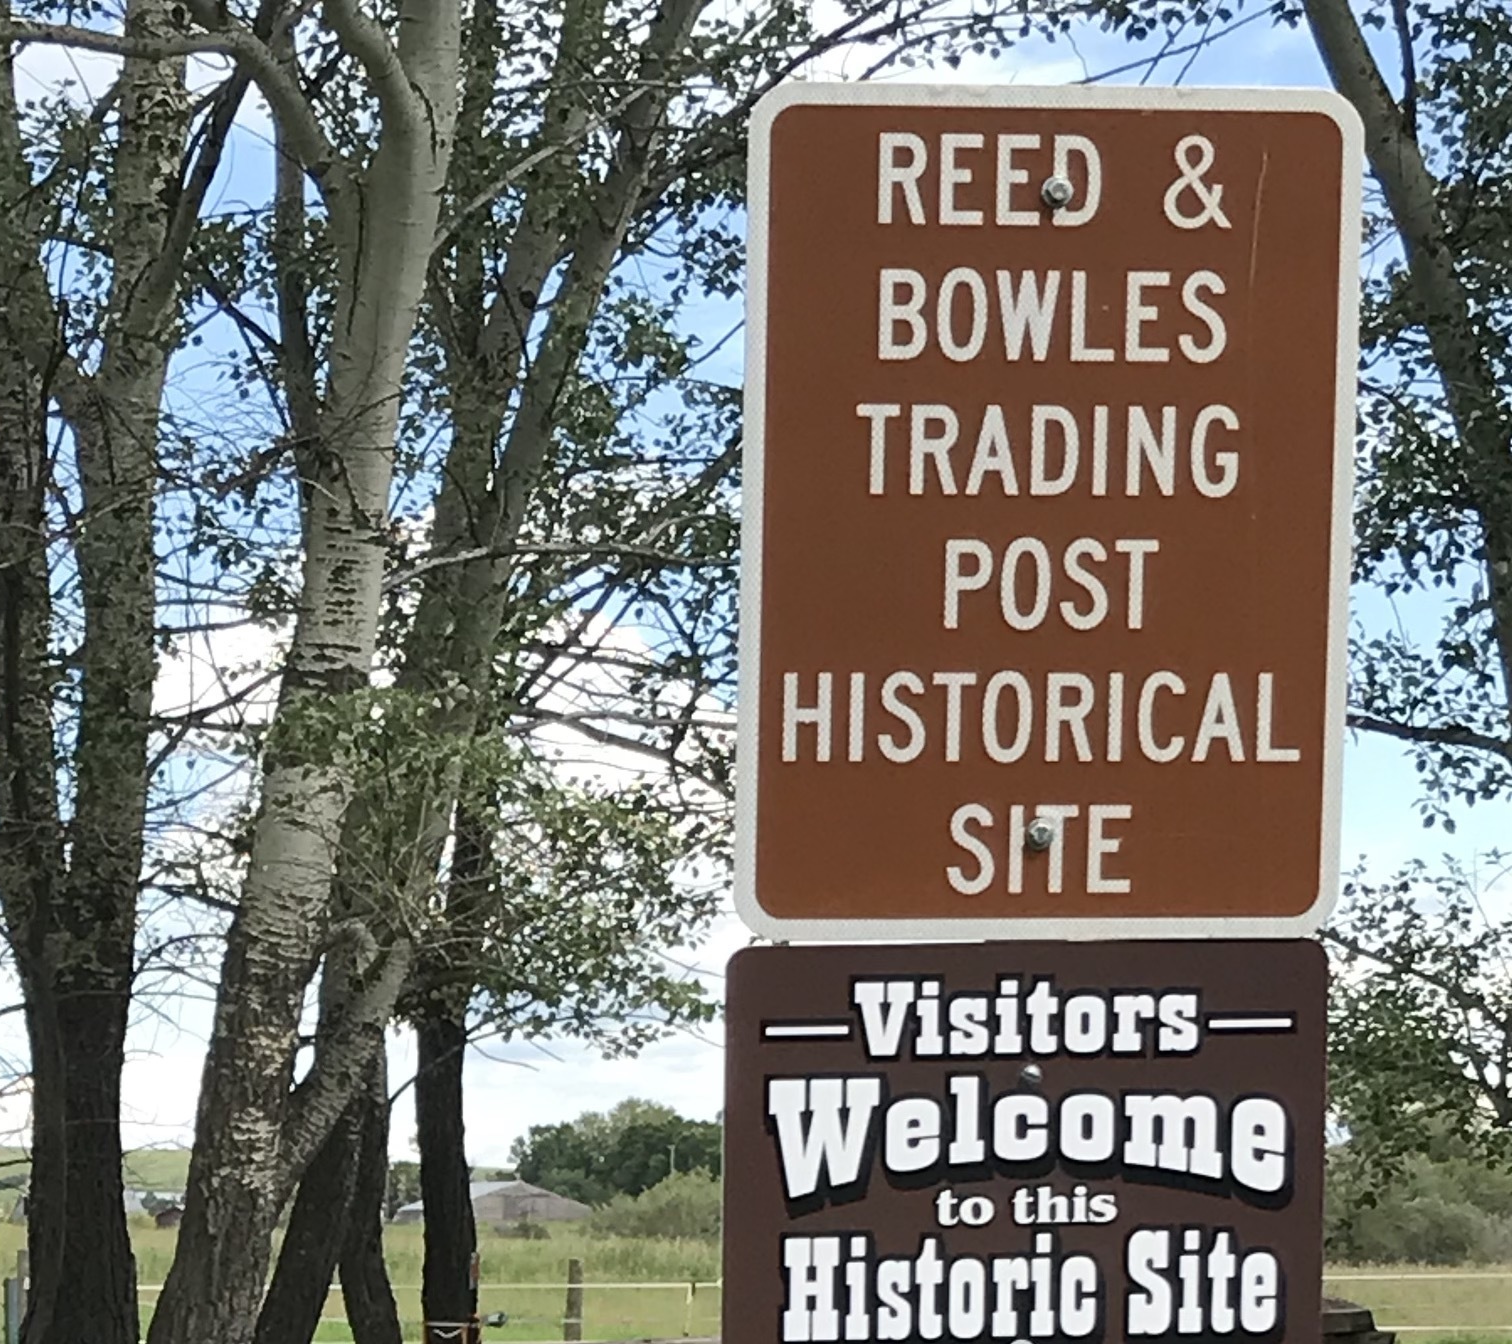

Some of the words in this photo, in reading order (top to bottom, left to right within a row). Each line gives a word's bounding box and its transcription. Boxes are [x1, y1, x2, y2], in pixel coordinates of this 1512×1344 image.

[879, 133, 1101, 225] REED
[1164, 136, 1231, 228] &
[879, 268, 1226, 363] BOWLES
[857, 404, 1239, 497] TRADING
[944, 538, 1159, 630] POST
[783, 671, 1300, 763] HISTORICAL
[947, 804, 1131, 894] SITE
[855, 980, 1198, 1055] Visitors
[769, 1077, 1285, 1199] Welcome
[937, 1190, 994, 1225] to
[1013, 1186, 1117, 1224] this
[784, 1234, 1096, 1341] Historic
[1129, 1230, 1276, 1334] Site
